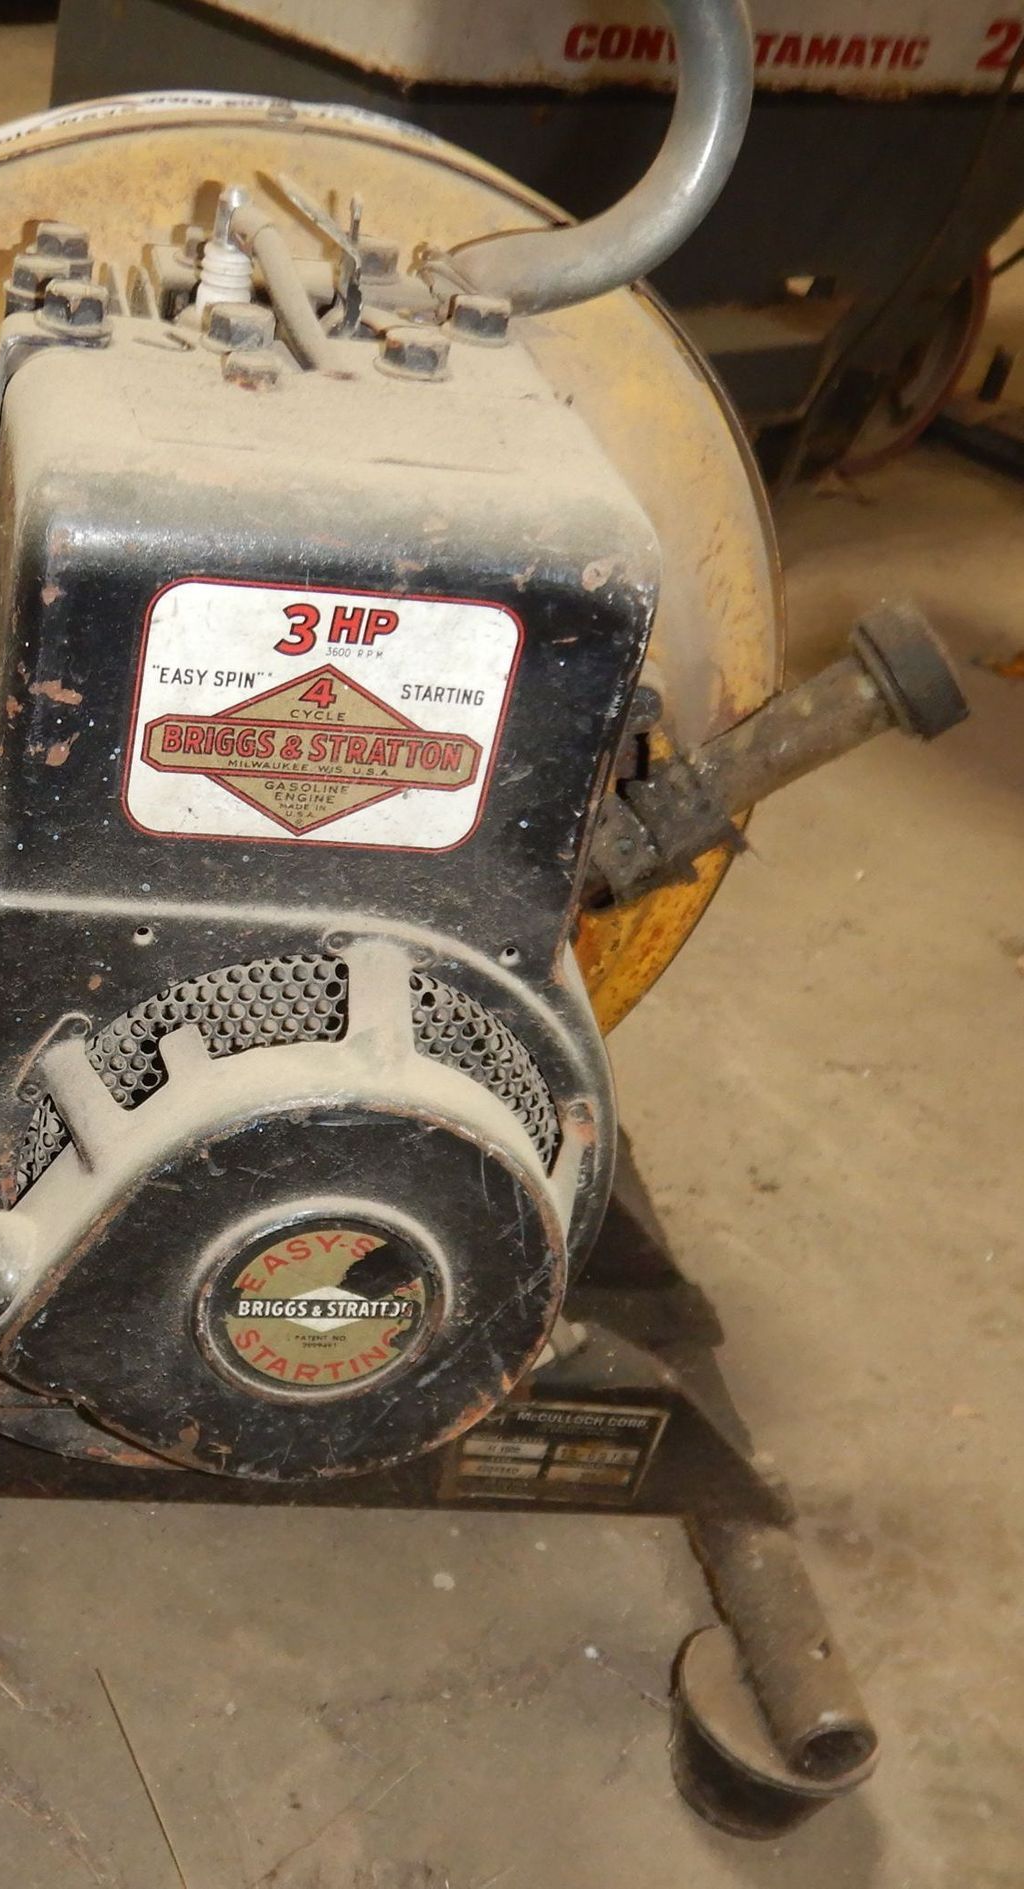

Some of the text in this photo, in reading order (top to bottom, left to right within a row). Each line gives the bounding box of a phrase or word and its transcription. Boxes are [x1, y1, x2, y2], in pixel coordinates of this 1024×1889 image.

[564, 24, 930, 71] CONTAMATIC
[273, 603, 399, 656] 3 HP
[325, 646, 351, 658] 3600
[298, 677, 337, 709] 4
[401, 684, 485, 706] STARTING
[290, 709, 346, 721] CYCLE
[161, 724, 464, 771] BRIGGS & STRATTON
[264, 781, 350, 795] GASOLINE
[274, 792, 336, 804] ENGINE
[280, 803, 309, 811] MADE
[238, 1301, 308, 1317] BRIGGS
[312, 1305, 323, 1317] &
